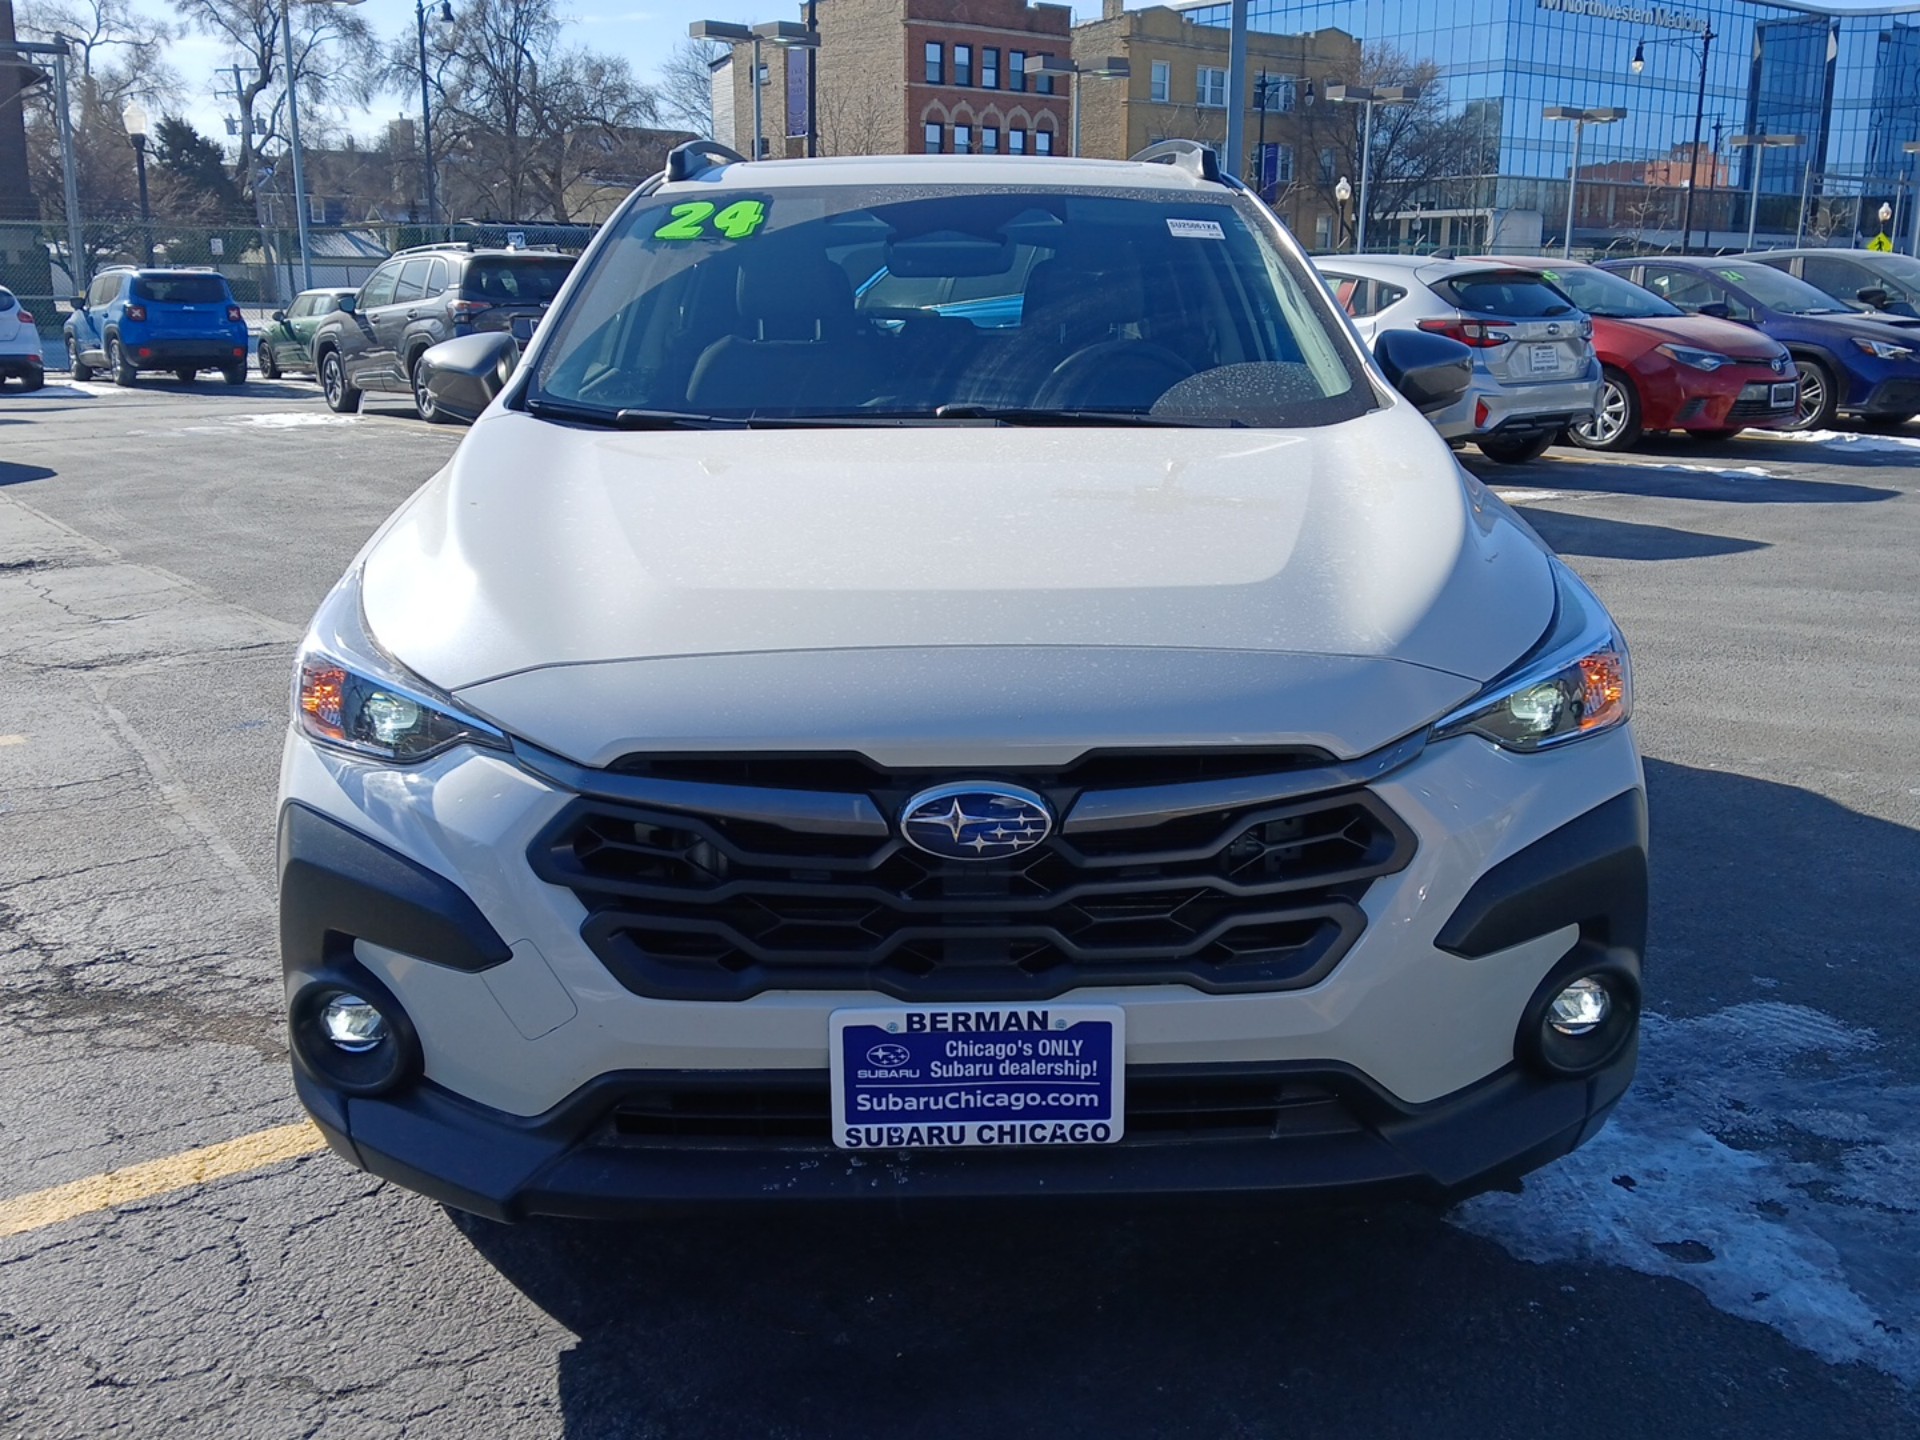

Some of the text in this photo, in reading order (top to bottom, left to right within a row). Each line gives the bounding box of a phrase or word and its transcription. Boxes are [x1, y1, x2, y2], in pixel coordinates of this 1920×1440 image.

[1563, 0, 1655, 24] Northwestern
[1655, 7, 1709, 32] Medicine
[654, 201, 764, 239] 24
[905, 1010, 1049, 1033] BERMAN
[945, 1039, 1084, 1060] Chicago's ONLY
[857, 1069, 920, 1079] SUBARU
[930, 1059, 1098, 1080] Subaru dealership!
[856, 1090, 1099, 1111] SubaruChicago.com
[845, 1123, 1111, 1147] SUBARU CHICAGO
